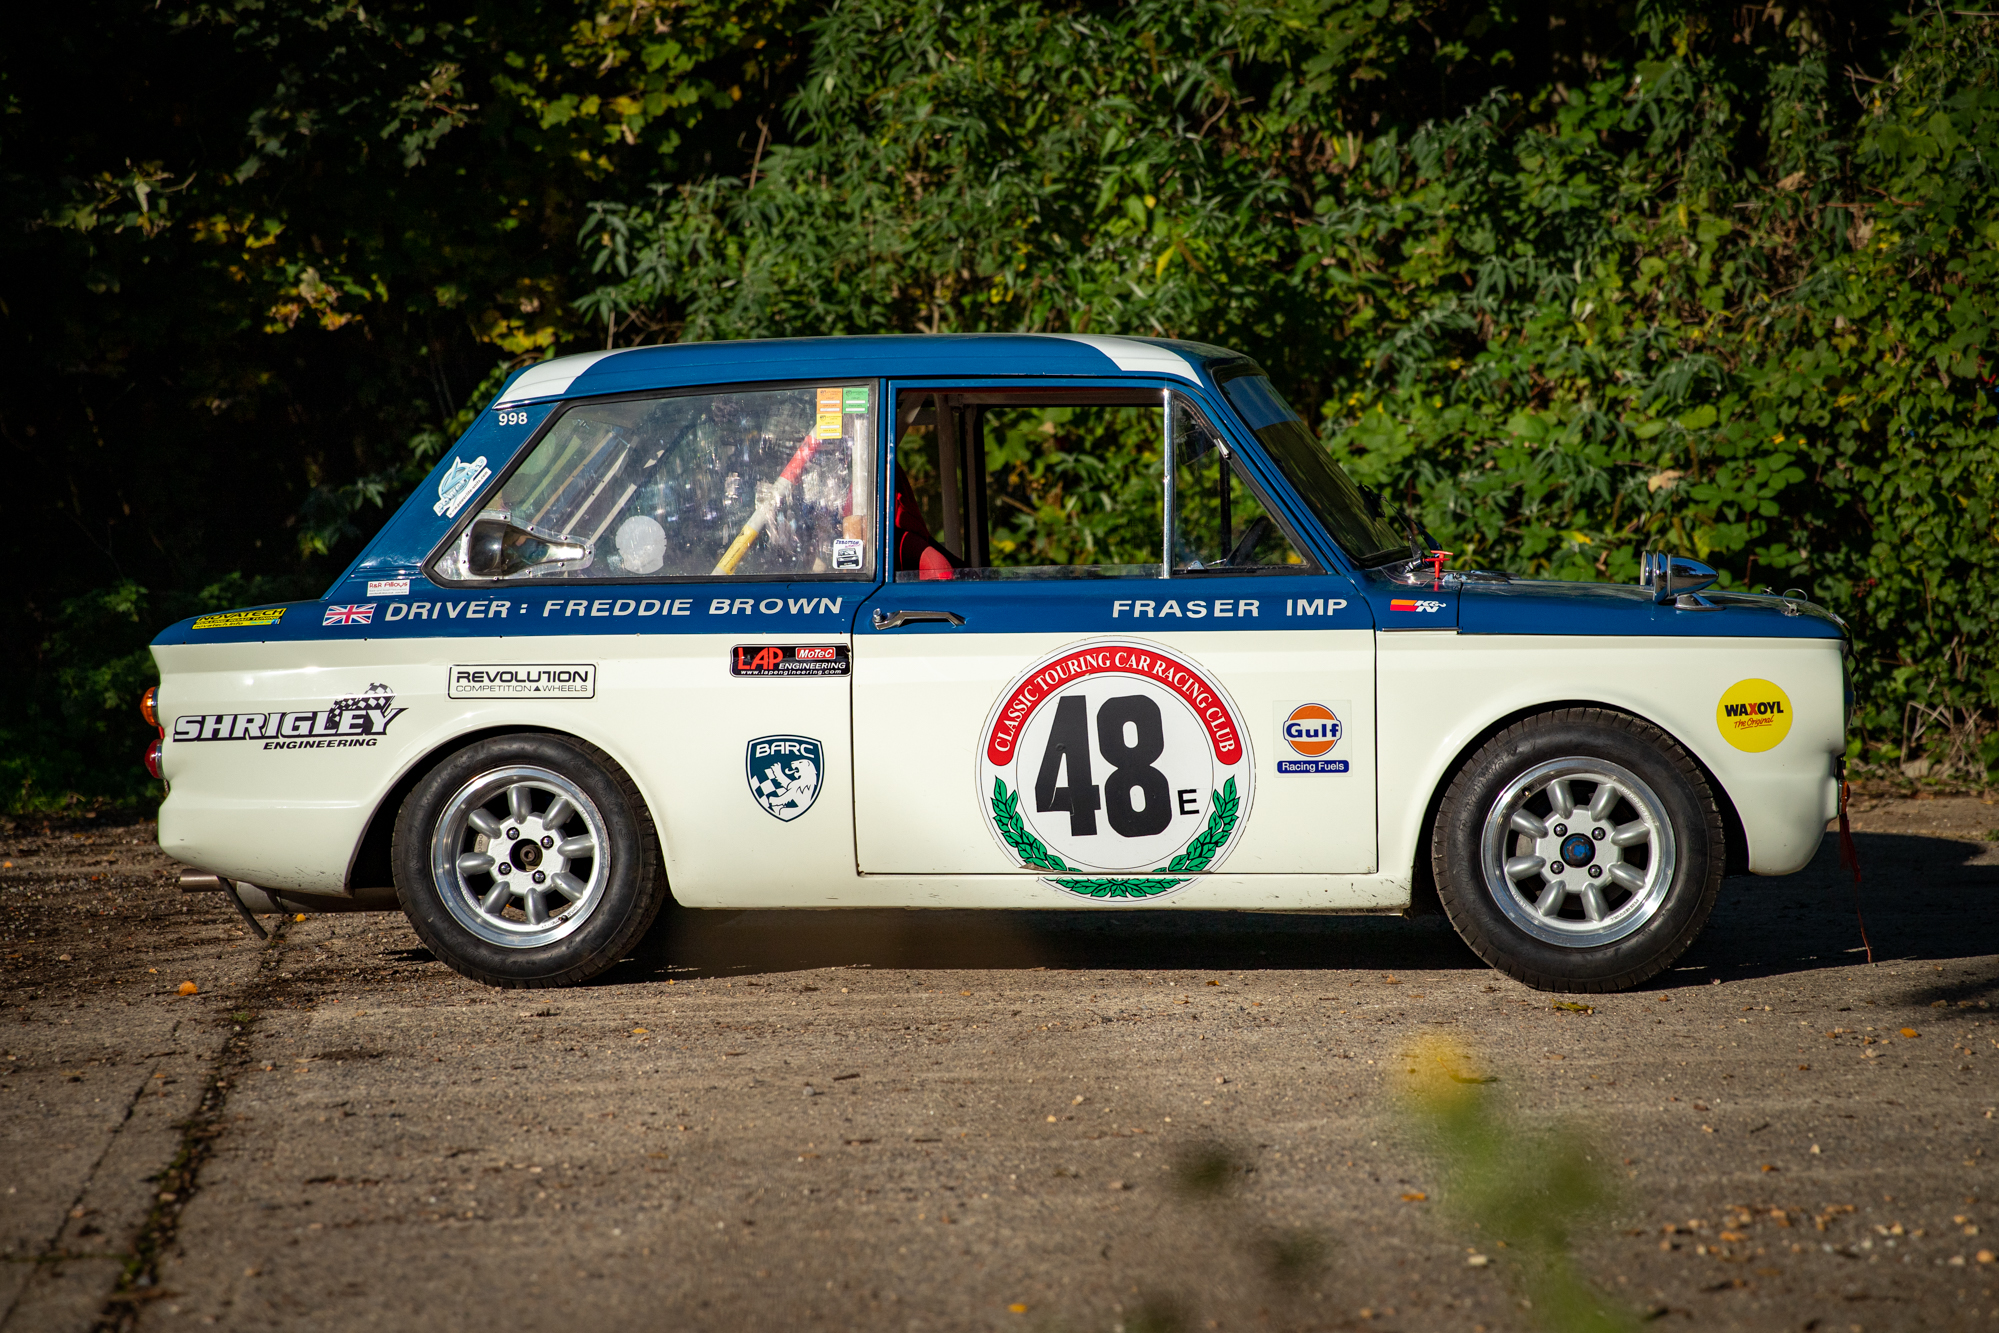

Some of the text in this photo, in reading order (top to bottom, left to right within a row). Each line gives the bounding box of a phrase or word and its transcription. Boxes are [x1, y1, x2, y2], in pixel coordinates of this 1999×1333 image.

[499, 412, 527, 426] 998
[542, 599, 693, 617] FREDDIE
[708, 597, 843, 615] BROWN
[1112, 599, 1348, 619] FRASER IMP
[1414, 600, 1447, 613] K&N
[199, 609, 284, 621] NOVATECH
[737, 647, 784, 670] LAP
[798, 649, 833, 659] MoTeC
[456, 670, 590, 683] REVOLUTION
[456, 683, 588, 692] COMPETITION WHEELS
[993, 651, 1237, 753] CLASSIC TOURING CAR RACING CLUB
[1724, 701, 1784, 717] WAXOYL
[172, 706, 409, 743] SHRIGLEY
[1286, 721, 1340, 739] Gulf
[1734, 719, 1746, 728] The
[262, 738, 378, 750] ENGINEERING
[755, 741, 815, 758] BARC
[1034, 694, 1173, 838] 48
[1282, 760, 1345, 773] Racing Fuels
[1177, 788, 1200, 815] E
